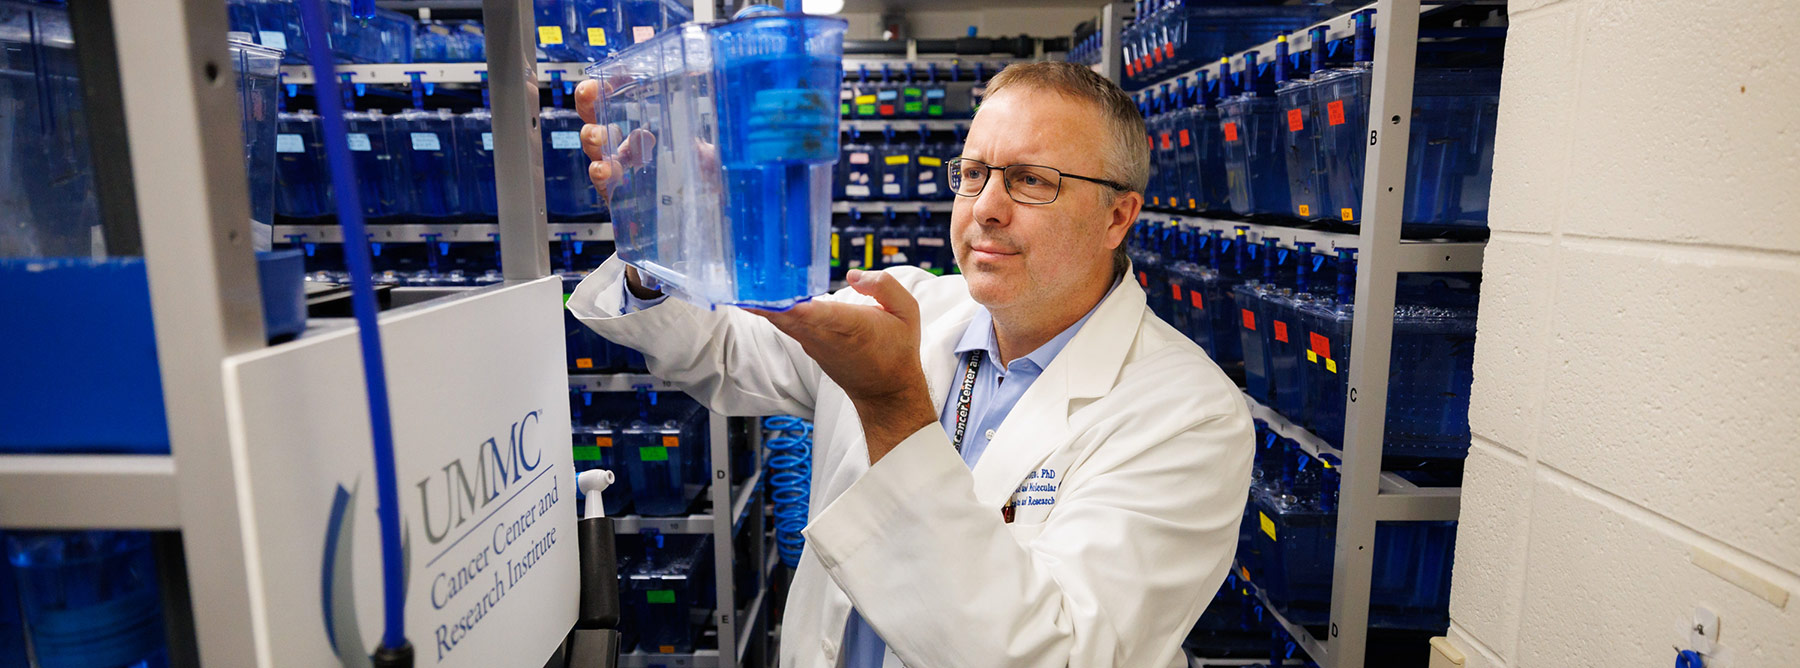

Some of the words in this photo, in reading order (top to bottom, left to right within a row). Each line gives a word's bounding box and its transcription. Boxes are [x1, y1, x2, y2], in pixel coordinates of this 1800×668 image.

[1370, 130, 1378, 146] B
[960, 368, 976, 404] Center
[1350, 387, 1358, 403] C
[953, 404, 969, 443] Cancer
[416, 410, 542, 545] UMMC
[716, 469, 726, 480] D
[1041, 468, 1056, 479] PhD
[1028, 495, 1055, 506] Research
[431, 546, 490, 611] Cancer
[492, 504, 537, 555] Center
[538, 475, 559, 517] and
[434, 571, 506, 664] Research
[506, 527, 557, 590] Institute
[722, 614, 729, 624] E
[1331, 622, 1339, 638] D
